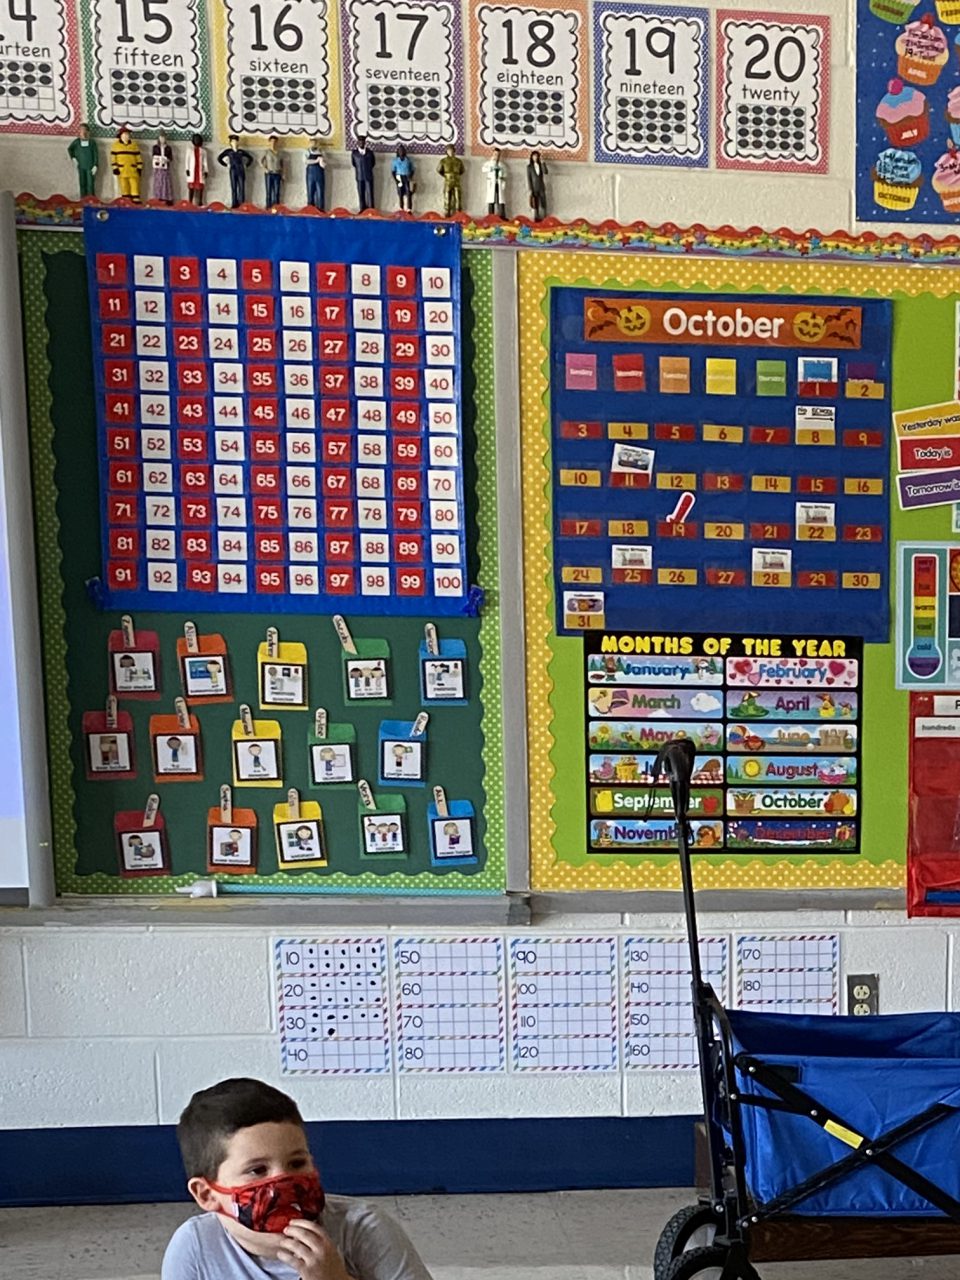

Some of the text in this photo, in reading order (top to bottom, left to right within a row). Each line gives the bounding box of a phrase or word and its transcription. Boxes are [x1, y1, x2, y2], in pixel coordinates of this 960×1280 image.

[0, 0, 37, 42] 4
[116, 0, 173, 44] 15
[250, 3, 303, 52] 16
[374, 12, 429, 61] 17
[502, 19, 556, 68] 18
[113, 47, 184, 68] fifteen
[625, 27, 676, 76] 19
[745, 34, 806, 83] 20
[249, 57, 309, 74] sixteen
[365, 67, 441, 83] seventeen
[497, 68, 564, 88] eighteen
[619, 80, 685, 96] nineteen
[742, 85, 800, 102] twenty
[901, 129, 918, 140] JULY
[878, 192, 911, 203] OCTOBER
[108, 263, 444, 290] 1 2 3 4 5 6 7 8 9 10
[143, 300, 158, 314] 12
[663, 307, 785, 339] October
[361, 341, 380, 355] 28
[183, 370, 202, 384] 33
[860, 385, 869, 397] 2
[218, 405, 238, 418] 44
[433, 411, 452, 424] 50
[901, 417, 943, 432] Yesterday
[578, 424, 867, 446] 3 4 5 6 7 8 9
[256, 440, 275, 453] 55
[914, 447, 952, 461] Today is
[292, 475, 311, 488] 66
[574, 472, 870, 492] 10 11 12 13 14 15 16
[906, 482, 952, 497] Tomorrow
[115, 503, 131, 517] 71
[397, 508, 417, 521] 79
[622, 522, 824, 539] 18 19 22
[115, 568, 461, 589] 91 92 93 94 95 96 97 98 99 100
[573, 569, 869, 586] 24 25 28 30
[577, 615, 591, 628] 31
[601, 635, 846, 657] MONTHS OF THE YEAR
[623, 661, 690, 680] January
[759, 663, 827, 681] February
[631, 694, 681, 709] March
[775, 697, 810, 713] April
[640, 728, 674, 742] May
[778, 729, 810, 743] June
[765, 762, 819, 779] August
[614, 793, 702, 811] Septemer
[761, 794, 824, 809] October
[286, 952, 300, 966] 10
[400, 950, 421, 964] 50
[517, 951, 537, 964] 90
[630, 951, 649, 962] 130
[743, 949, 761, 960] 170
[402, 983, 422, 996] 60
[518, 983, 537, 995] 100
[743, 981, 761, 992] 180
[286, 1017, 306, 1030] 30
[520, 1016, 536, 1028] 110
[630, 1014, 650, 1025] 150
[288, 1049, 308, 1062] 40
[405, 1047, 424, 1060] 80
[630, 1045, 650, 1056] 160
